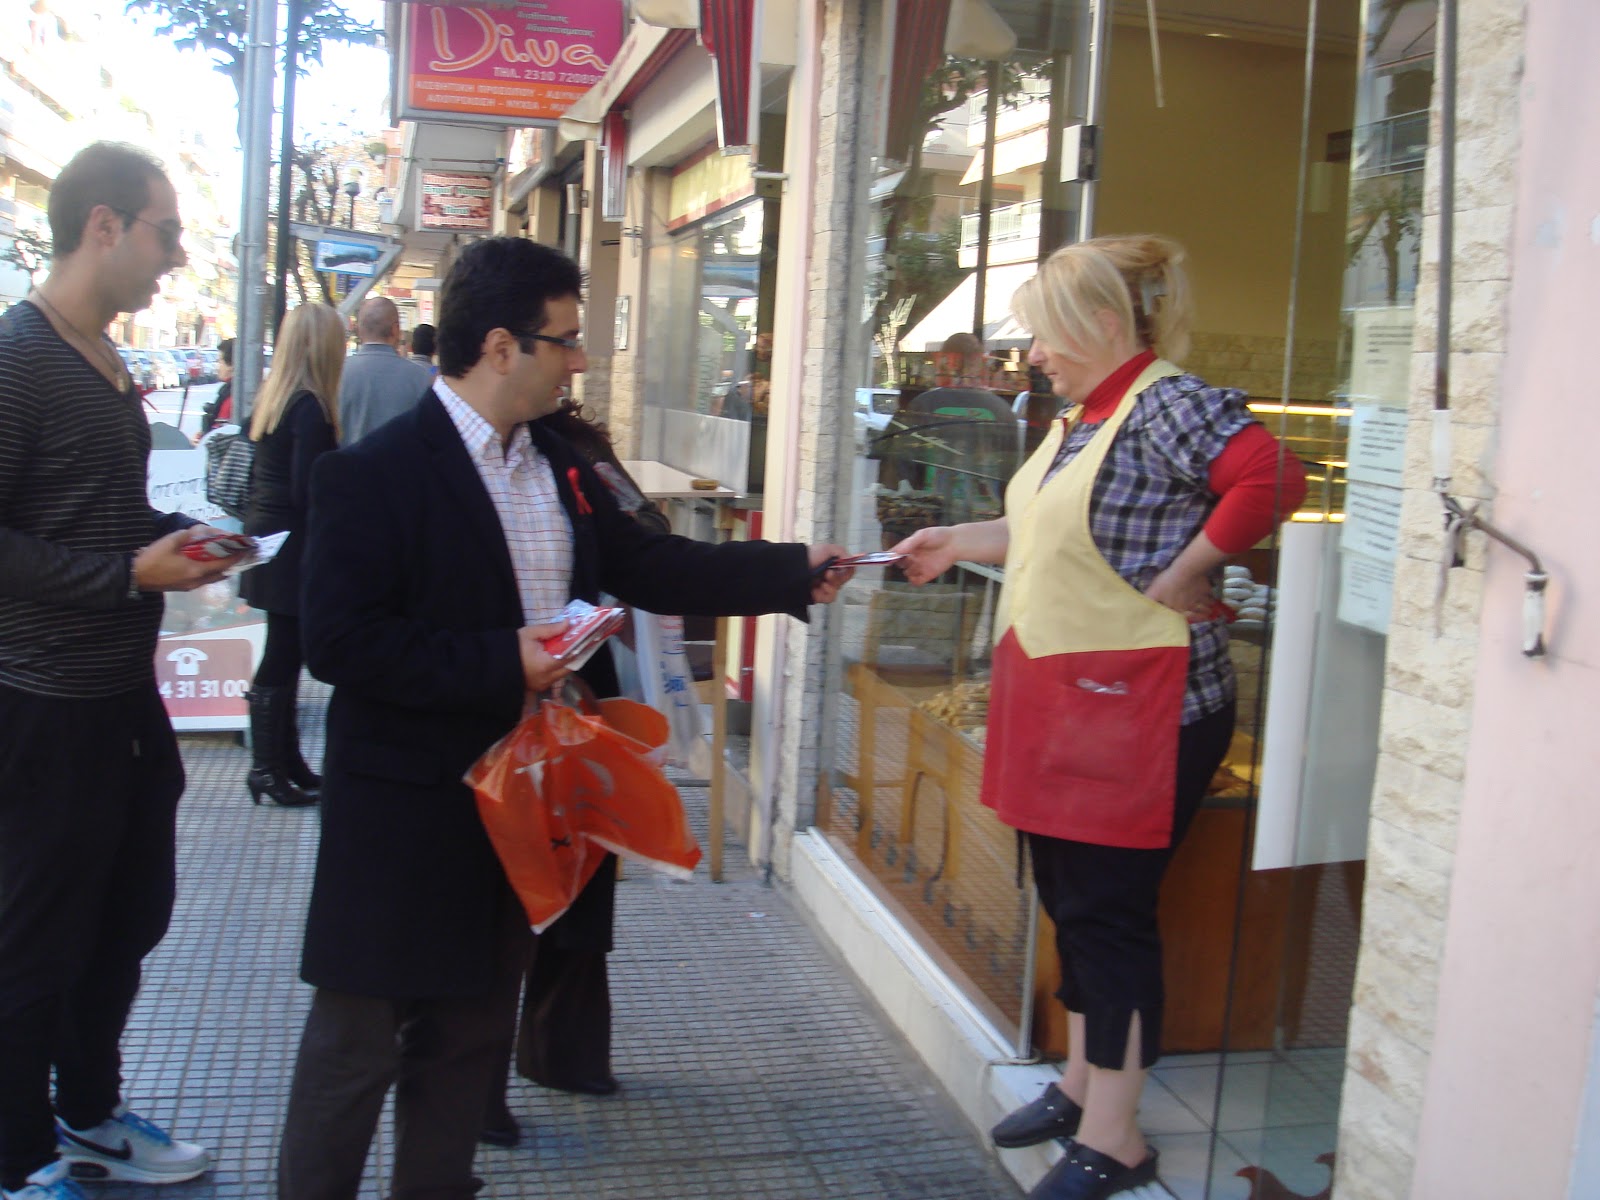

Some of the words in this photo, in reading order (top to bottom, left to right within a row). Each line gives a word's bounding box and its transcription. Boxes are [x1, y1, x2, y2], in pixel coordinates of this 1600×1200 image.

[429, 6, 610, 72] Diva
[524, 69, 555, 81] 2310
[176, 681, 195, 698] 31
[200, 680, 219, 698] 31
[223, 680, 250, 697] 00
